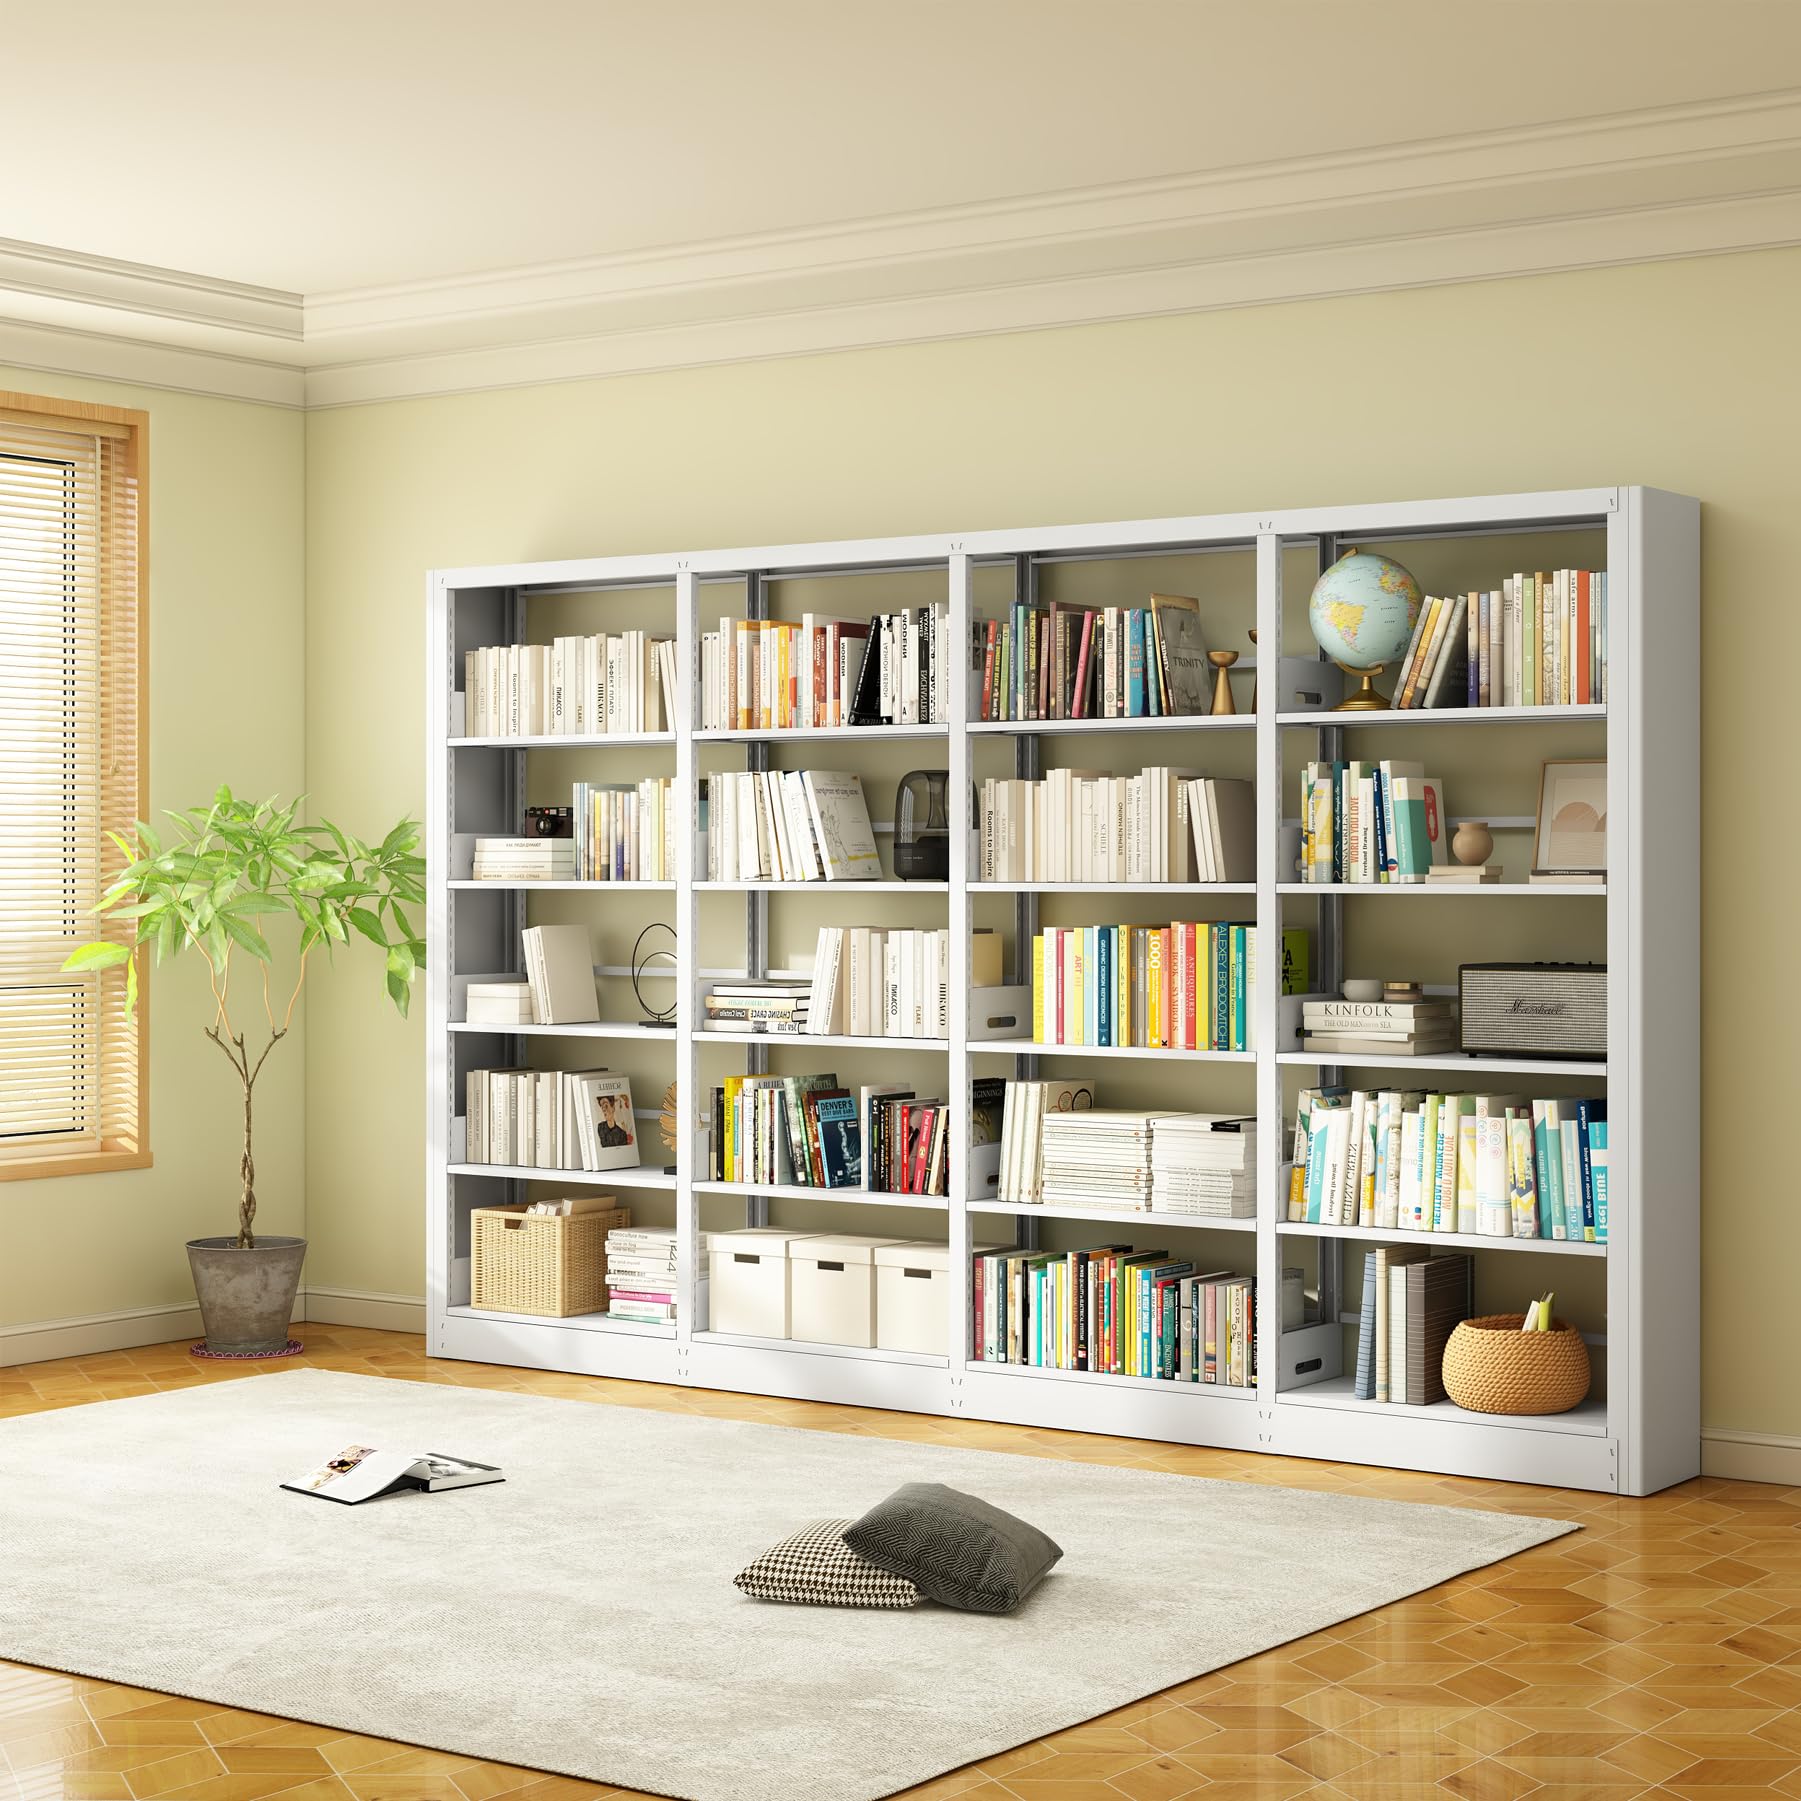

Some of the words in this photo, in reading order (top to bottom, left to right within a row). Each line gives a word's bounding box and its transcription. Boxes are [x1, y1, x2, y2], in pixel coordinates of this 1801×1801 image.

[1160, 640, 1170, 672] TRINITY
[1172, 656, 1205, 670] TRINITY
[1350, 796, 1359, 816] LOVE
[1350, 818, 1359, 834] YOU
[986, 850, 994, 877] Inspire
[1350, 836, 1359, 864] WORLD
[1150, 934, 1160, 968] 1000
[1218, 926, 1227, 968] ALEXEY
[1218, 972, 1227, 1042] BRODOVITCH
[1324, 1004, 1392, 1017] KINFOLK
[820, 1100, 854, 1111] DENVER'S
